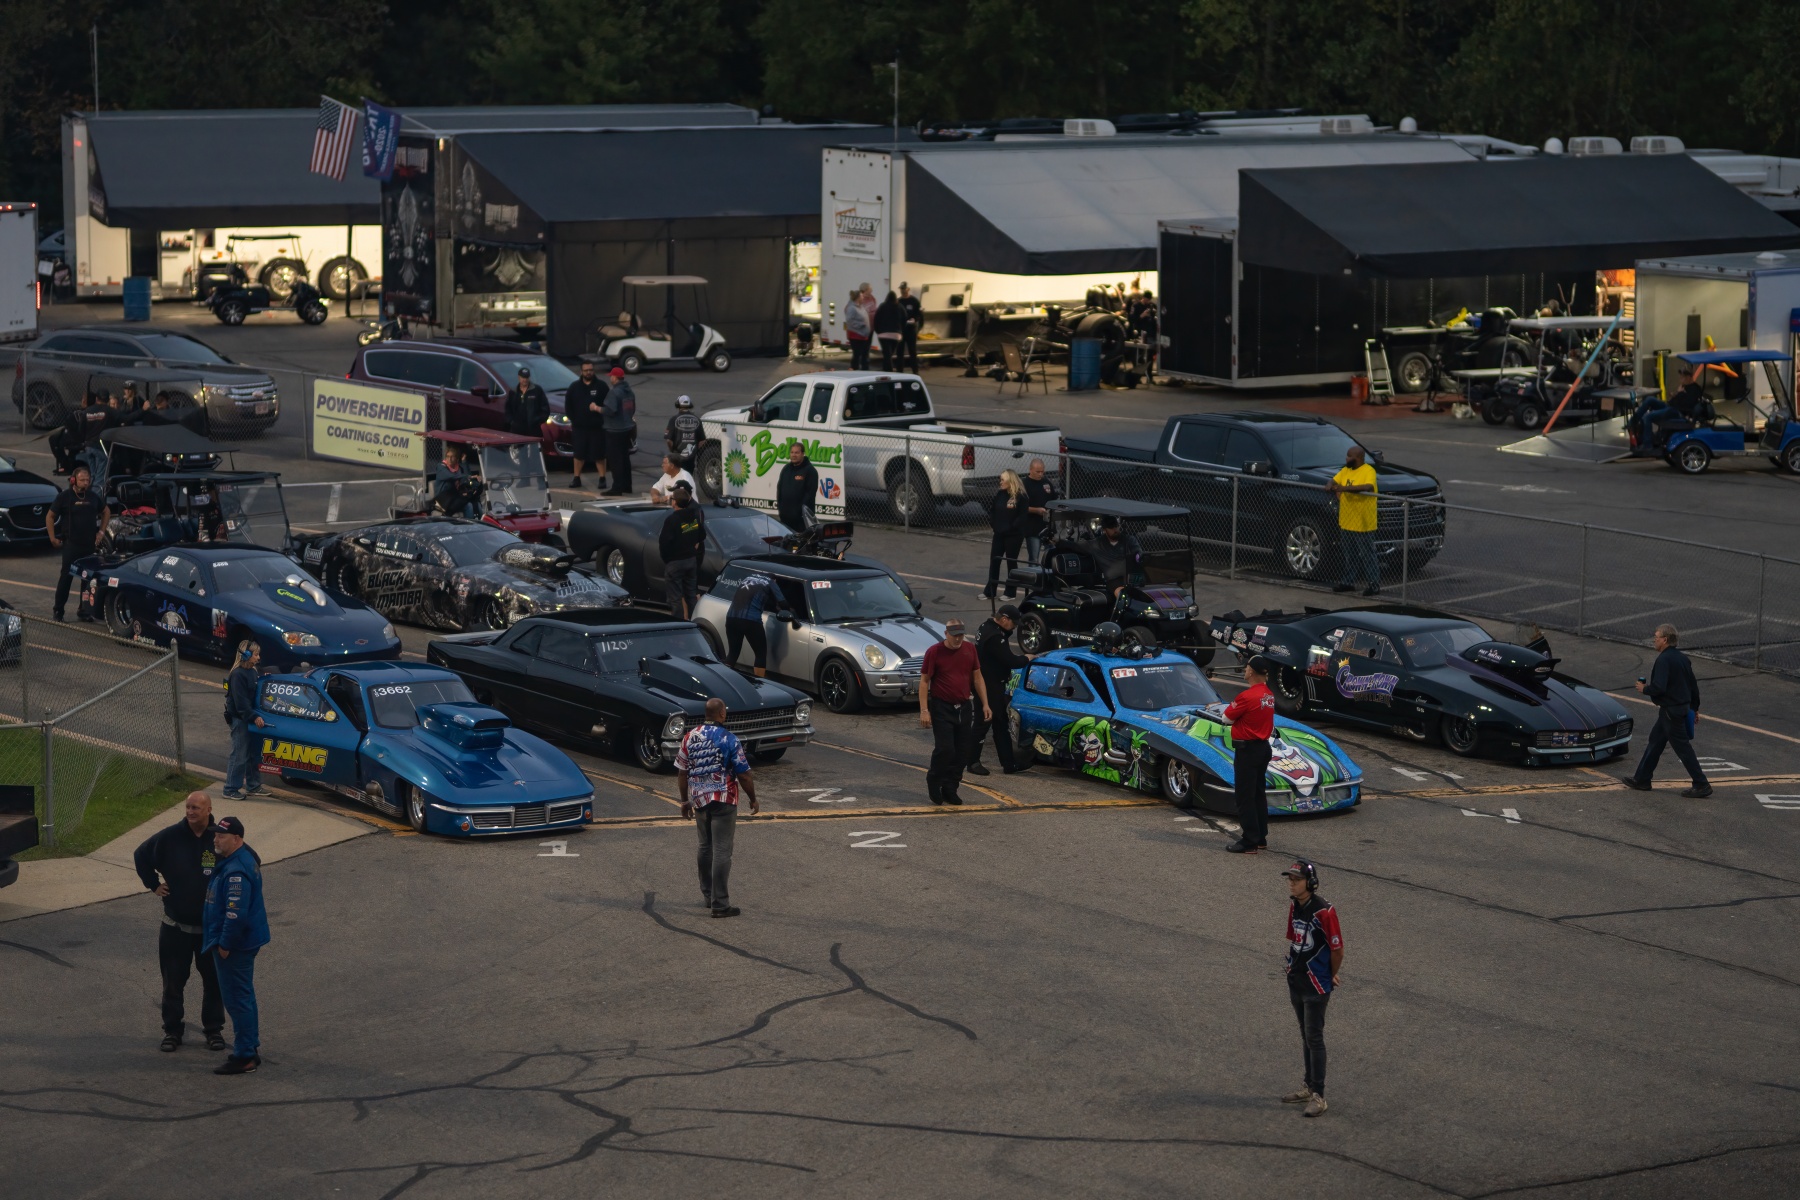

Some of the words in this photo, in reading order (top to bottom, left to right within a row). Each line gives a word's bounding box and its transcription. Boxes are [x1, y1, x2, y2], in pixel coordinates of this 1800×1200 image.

[838, 215, 881, 233] HUSSEY
[316, 393, 423, 425] POWERSHIELD
[326, 425, 410, 449] COATINGS.COM
[736, 432, 748, 444] bp
[366, 569, 407, 589] BLACK
[375, 588, 423, 610] MAMBA
[601, 641, 628, 653] 1120
[269, 683, 301, 697] 3662
[378, 685, 412, 696] 3662
[271, 702, 286, 712] Ken
[261, 737, 329, 767] LANG
[262, 753, 324, 774] Transmission
[848, 830, 908, 848] 2
